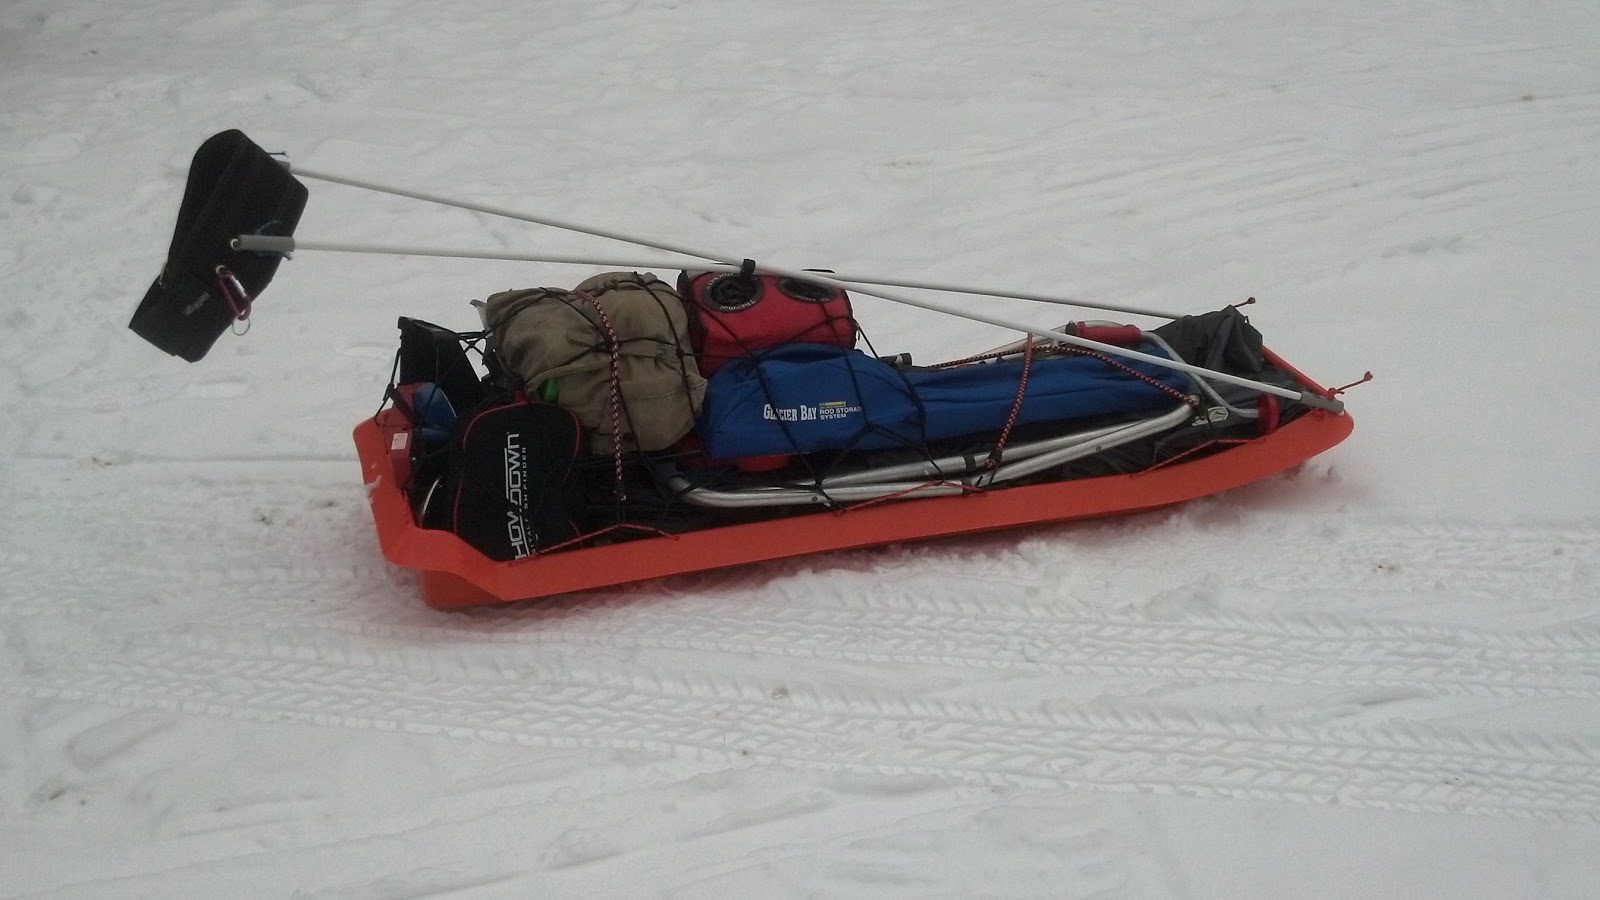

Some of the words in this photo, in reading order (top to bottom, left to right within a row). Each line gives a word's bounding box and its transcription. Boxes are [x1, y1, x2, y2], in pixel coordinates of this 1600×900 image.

[719, 299, 757, 311] Thermal
[800, 404, 817, 421] BAY
[819, 407, 835, 415] ROD
[835, 406, 861, 414] STORAG
[506, 433, 527, 560] HOWDOWN
